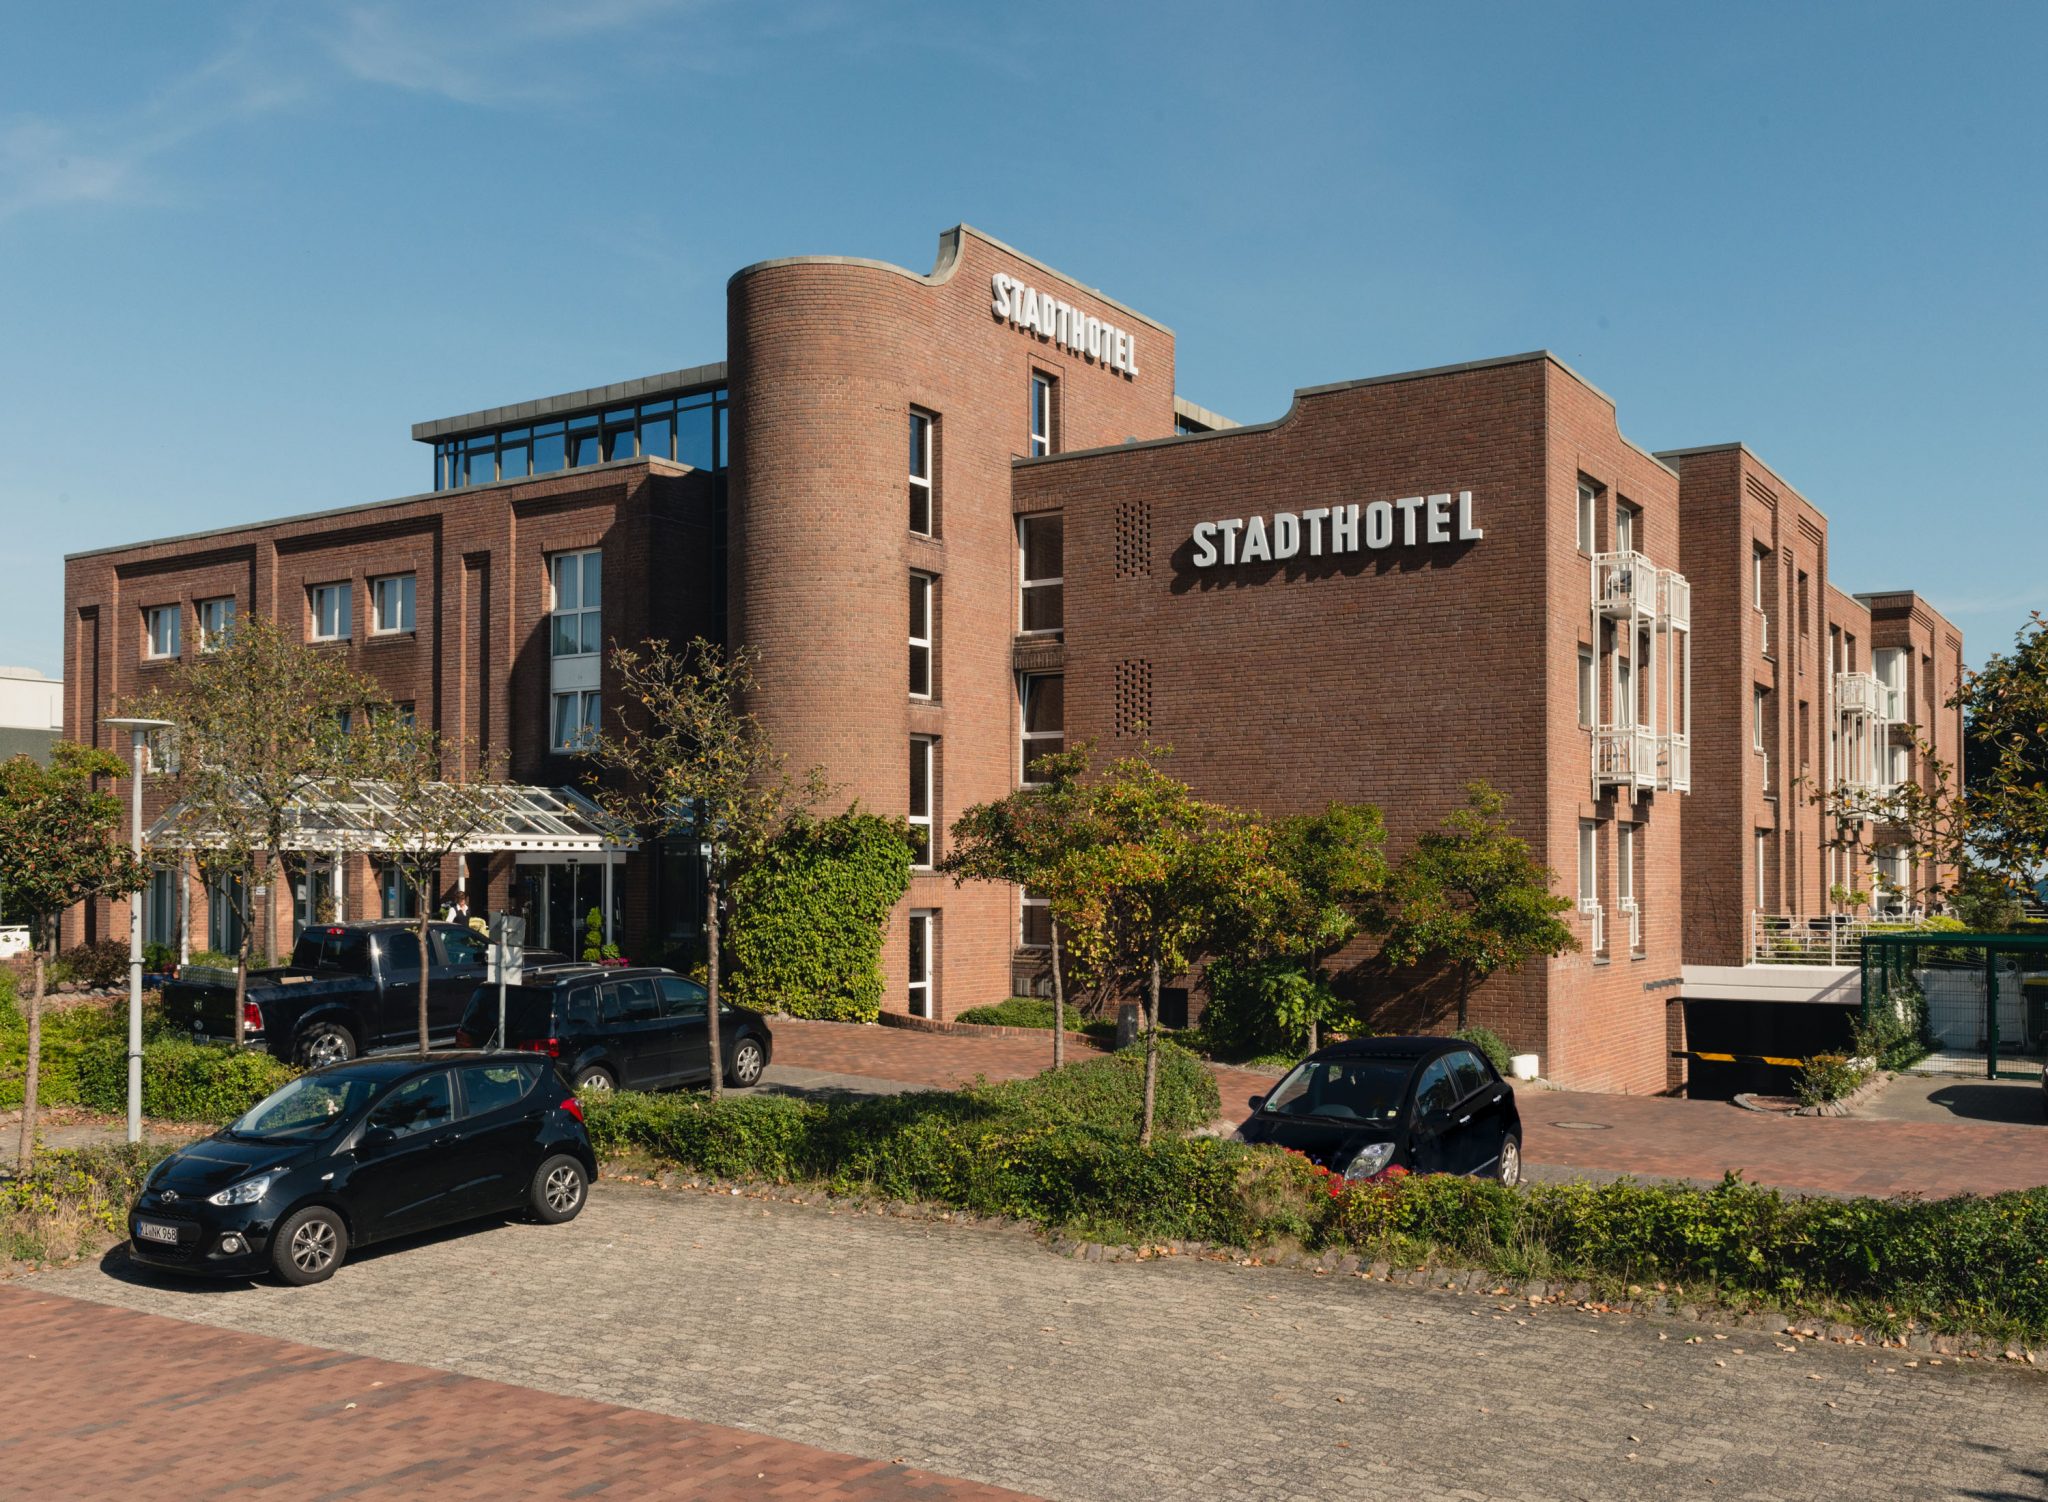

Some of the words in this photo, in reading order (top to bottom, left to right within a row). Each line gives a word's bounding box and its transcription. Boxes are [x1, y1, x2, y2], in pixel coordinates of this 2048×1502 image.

[991, 272, 1139, 377] STADTHOTEL
[1192, 490, 1483, 568] STADTHOTEL
[162, 1227, 177, 1241] 968
